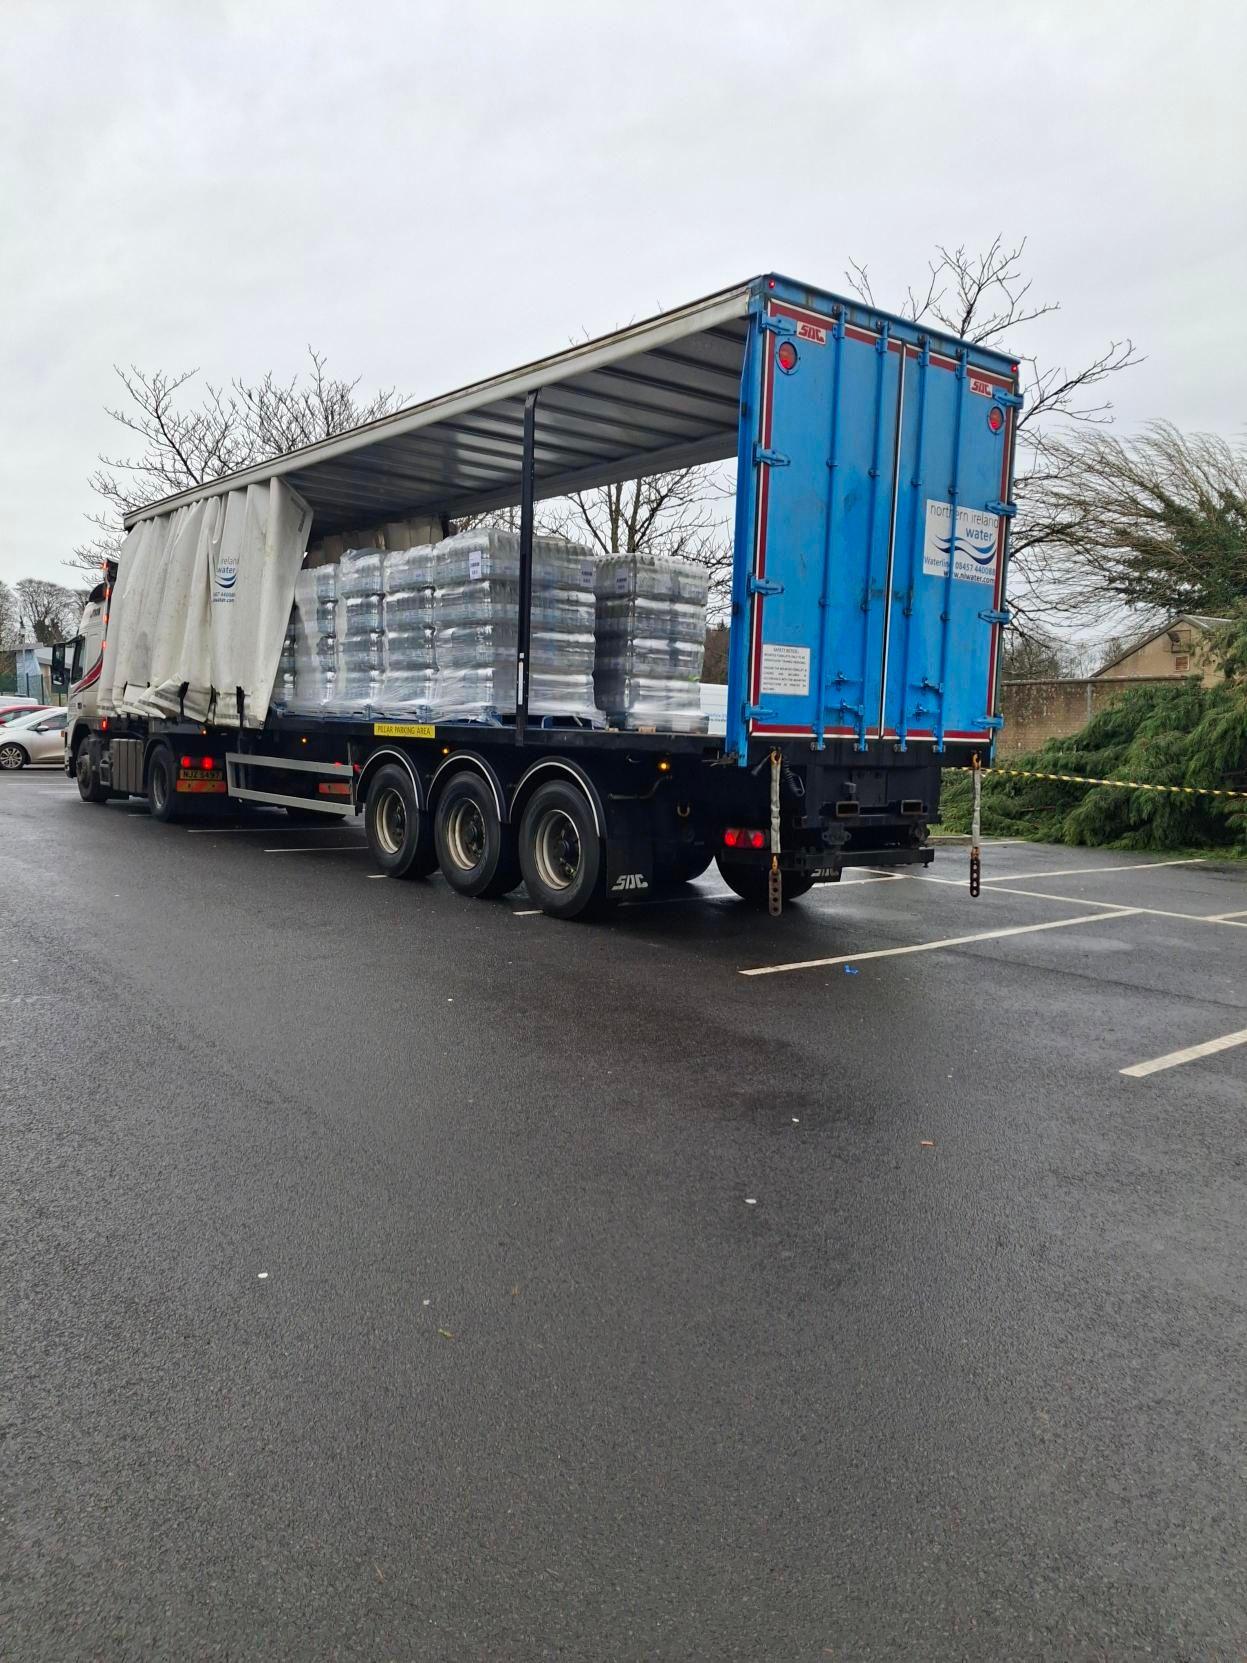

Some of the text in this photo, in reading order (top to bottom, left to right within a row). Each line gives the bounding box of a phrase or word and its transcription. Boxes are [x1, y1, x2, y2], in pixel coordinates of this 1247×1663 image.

[971, 513, 998, 529] ireland
[965, 527, 993, 542] water
[416, 727, 431, 735] AREA
[611, 874, 648, 890] SDC
